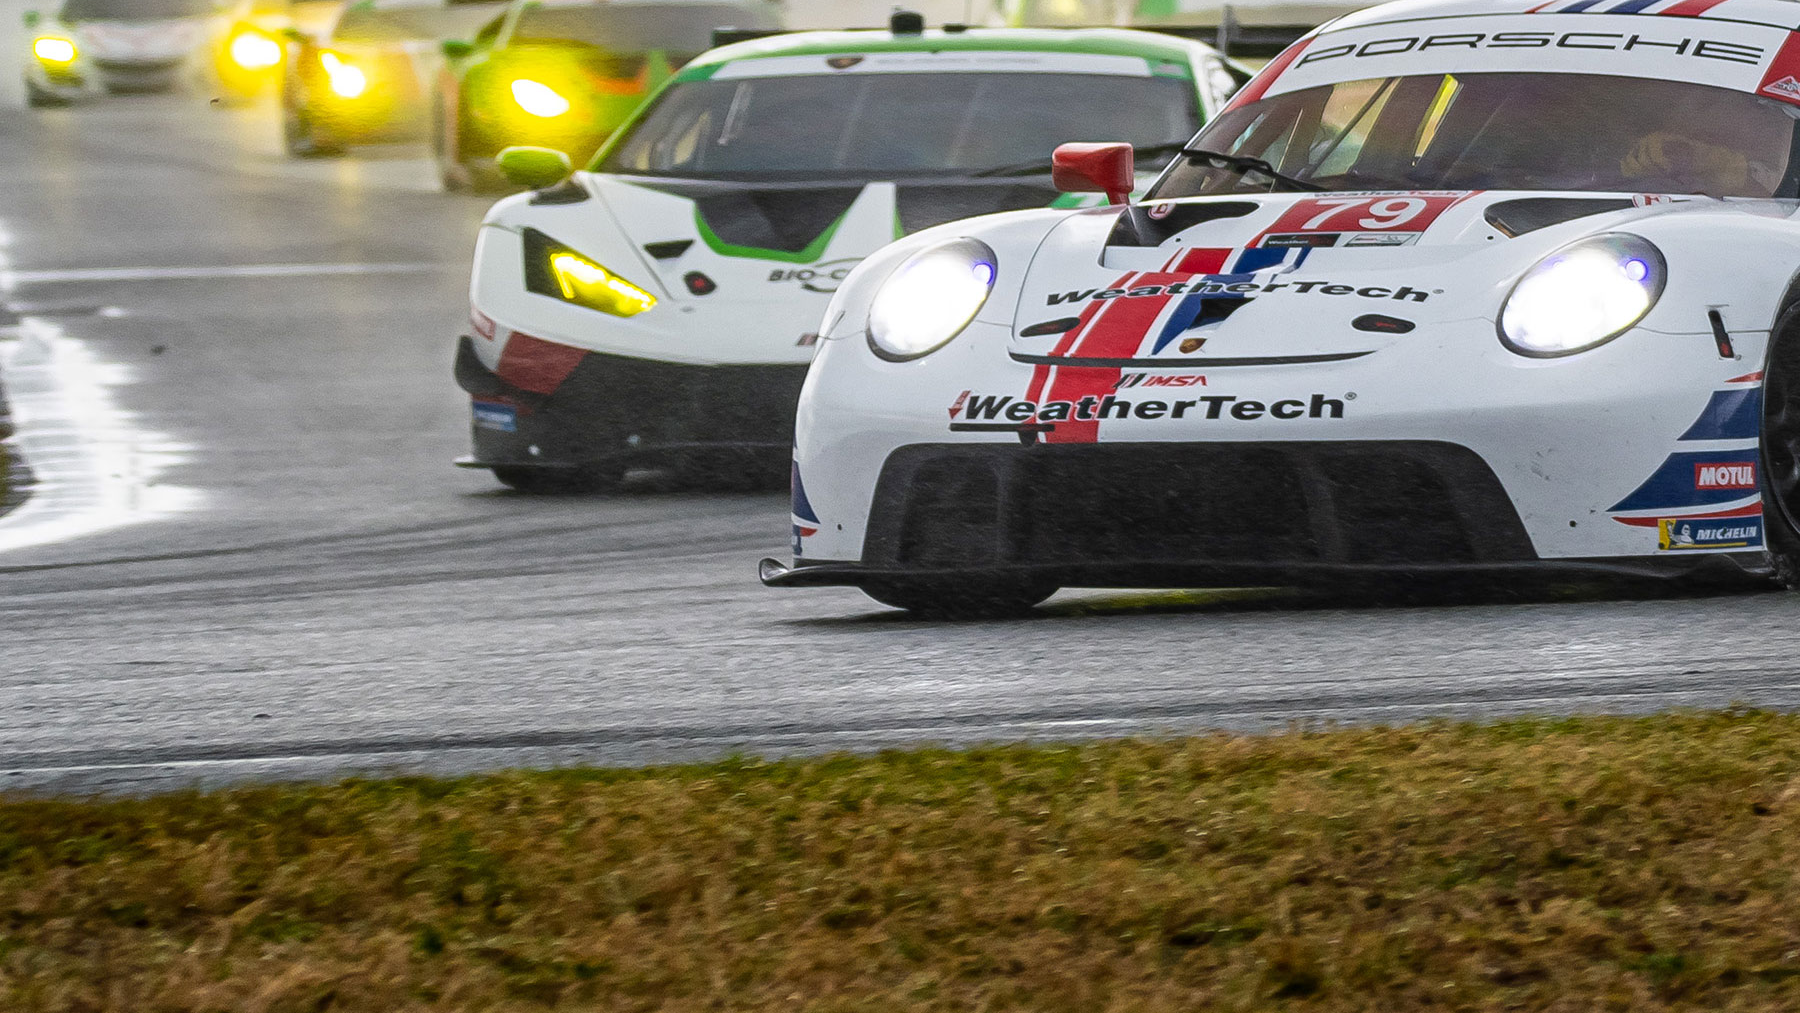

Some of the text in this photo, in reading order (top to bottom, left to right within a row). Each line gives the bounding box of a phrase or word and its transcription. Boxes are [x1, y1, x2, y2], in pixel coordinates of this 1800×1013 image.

[1294, 31, 1765, 70] PORSCHE
[1300, 197, 1428, 230] 79
[1140, 375, 1208, 387] IMSA
[1698, 466, 1754, 486] MOTUL
[1696, 525, 1758, 540] MICHELIN
